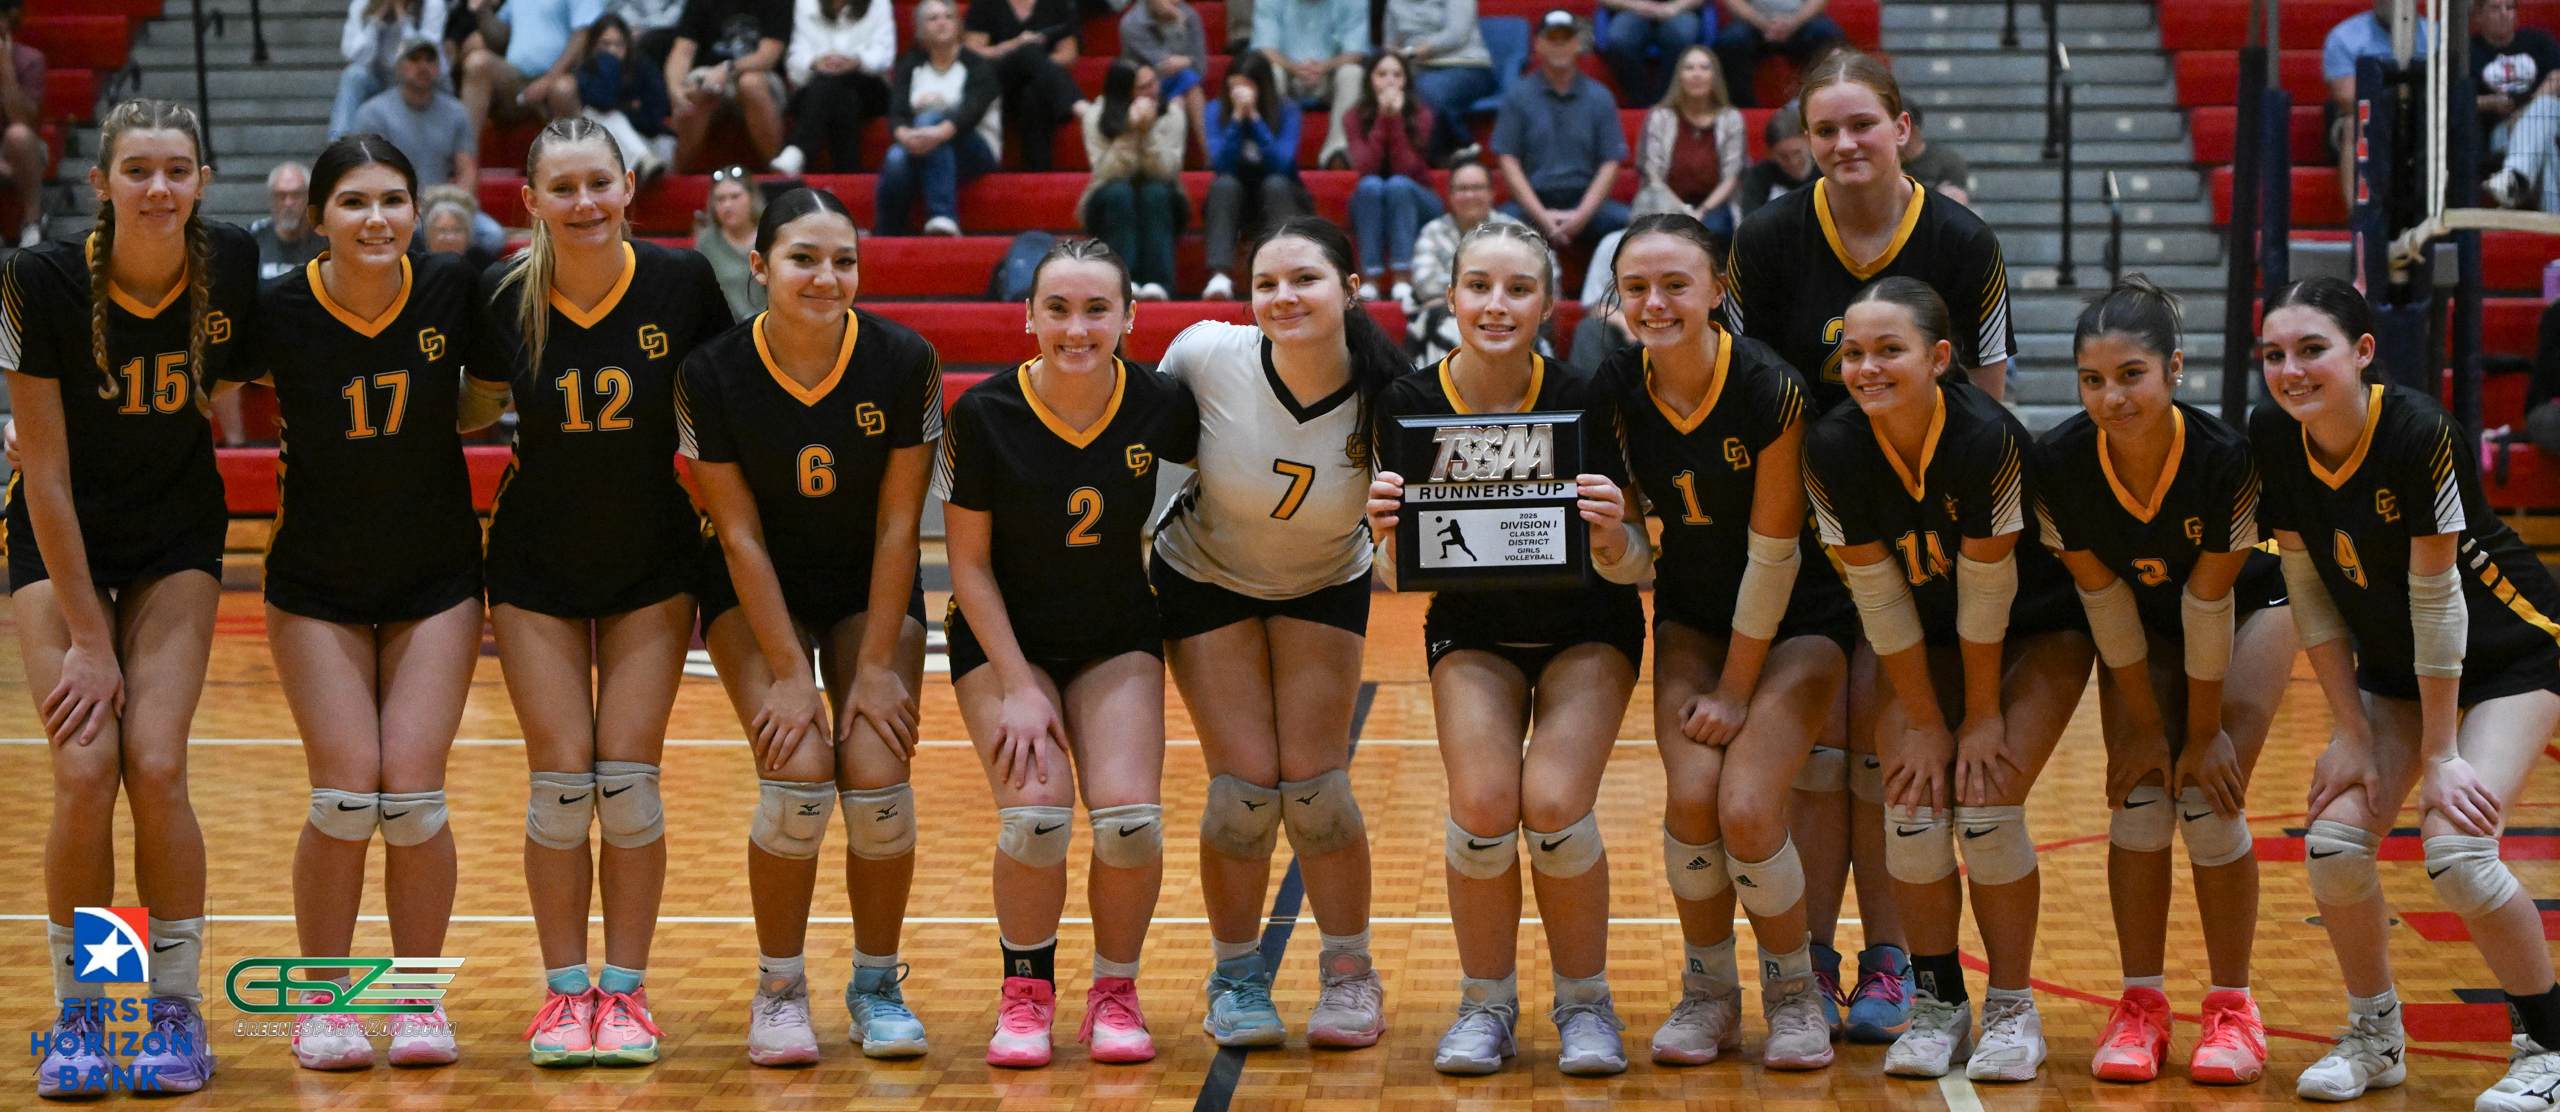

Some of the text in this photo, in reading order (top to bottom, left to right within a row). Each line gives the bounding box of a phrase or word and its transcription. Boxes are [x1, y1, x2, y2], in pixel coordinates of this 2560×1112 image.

[418, 326, 446, 362] CD
[638, 323, 669, 360] CD
[118, 350, 190, 415] 15
[341, 369, 411, 440] 17
[555, 365, 634, 433] 12
[855, 401, 887, 437] CD
[796, 443, 837, 498] 6
[1125, 443, 1153, 477] CD
[1429, 424, 1554, 481] TSSAA
[1723, 436, 1752, 471] CD
[1065, 485, 1105, 548] 2
[1270, 458, 1316, 520] 7
[1419, 482, 1565, 500] RUNNERS-UP
[1672, 469, 1714, 526] 1
[1500, 519, 1557, 530] DIVISION I
[1508, 538, 1550, 546] DISTRICT
[1509, 530, 1536, 538] CLASS
[1895, 530, 1953, 587] 14
[2333, 528, 2369, 590] 9
